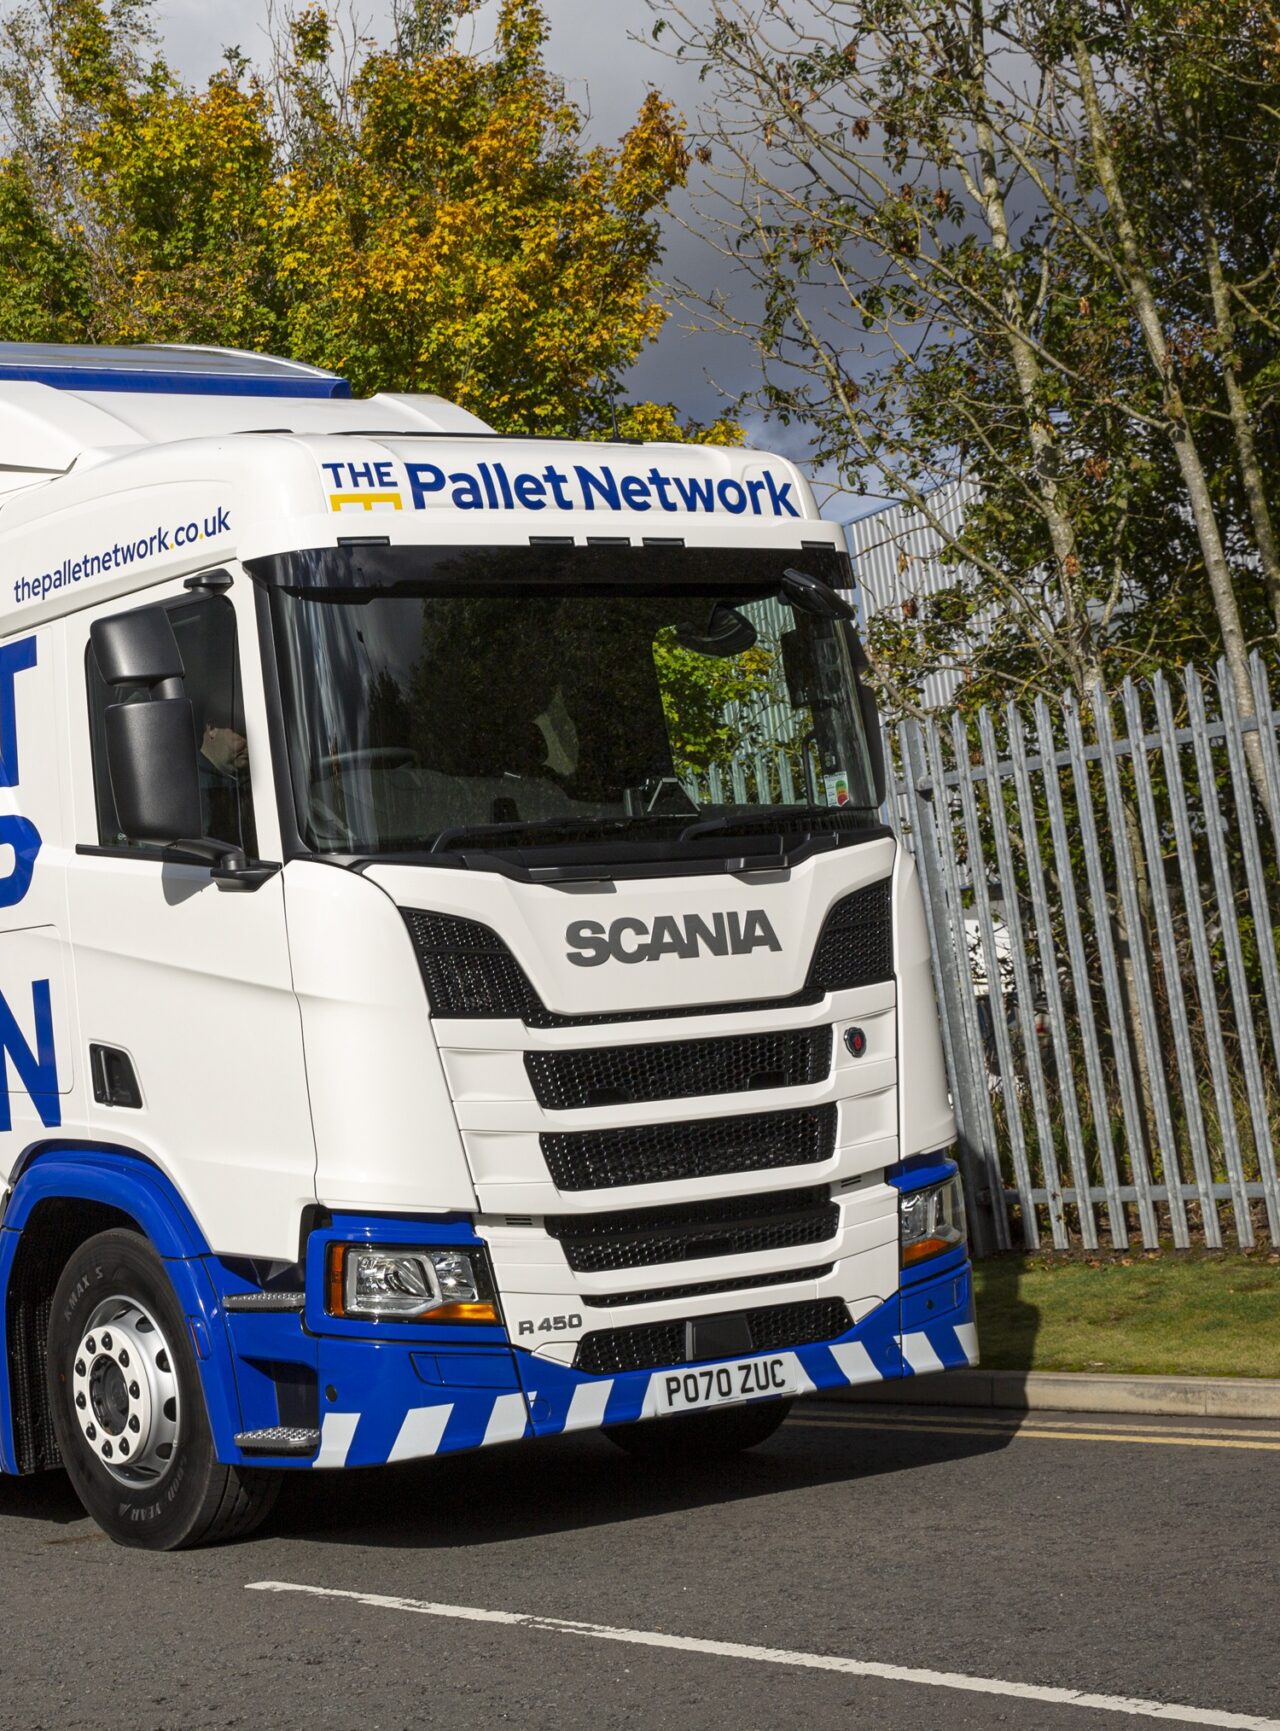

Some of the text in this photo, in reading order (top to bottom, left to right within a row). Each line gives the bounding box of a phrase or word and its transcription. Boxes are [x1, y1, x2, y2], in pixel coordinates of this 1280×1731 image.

[322, 461, 398, 488] THE
[13, 506, 231, 603] thepalletnetwork.co.uk
[565, 909, 783, 968] SCANIA
[518, 1313, 583, 1336] R 450
[665, 1358, 786, 1407] PO70 ZUC
